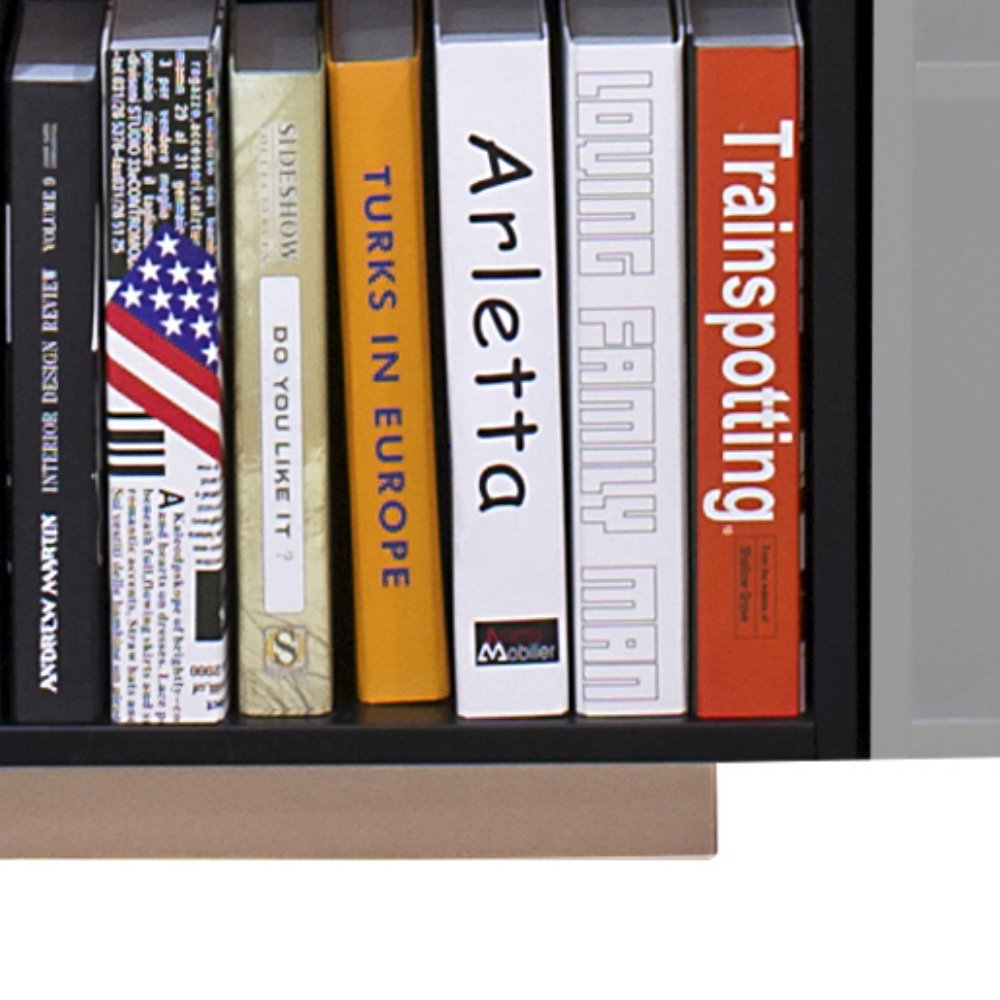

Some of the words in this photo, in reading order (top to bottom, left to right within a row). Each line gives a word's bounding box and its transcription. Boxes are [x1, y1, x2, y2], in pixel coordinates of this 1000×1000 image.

[41, 190, 58, 252] VOLUME
[277, 122, 298, 261] SIDESHOW
[362, 164, 398, 312] TURKS
[41, 268, 59, 333] REVIEW
[467, 133, 543, 513] Arletta
[702, 119, 795, 522] Trainspotting
[41, 341, 59, 404] DESIGN
[273, 326, 289, 364] DO
[370, 334, 401, 383] IN
[273, 376, 289, 431] YOU
[578, 305, 657, 534] FAMILY
[41, 411, 59, 494] INTERIOR
[274, 442, 291, 502] LIKE
[159, 488, 185, 509] A
[275, 513, 292, 539] IT
[373, 408, 411, 588] EUROPE
[39, 514, 59, 597] MARTIN
[39, 598, 59, 694] ANDREW
